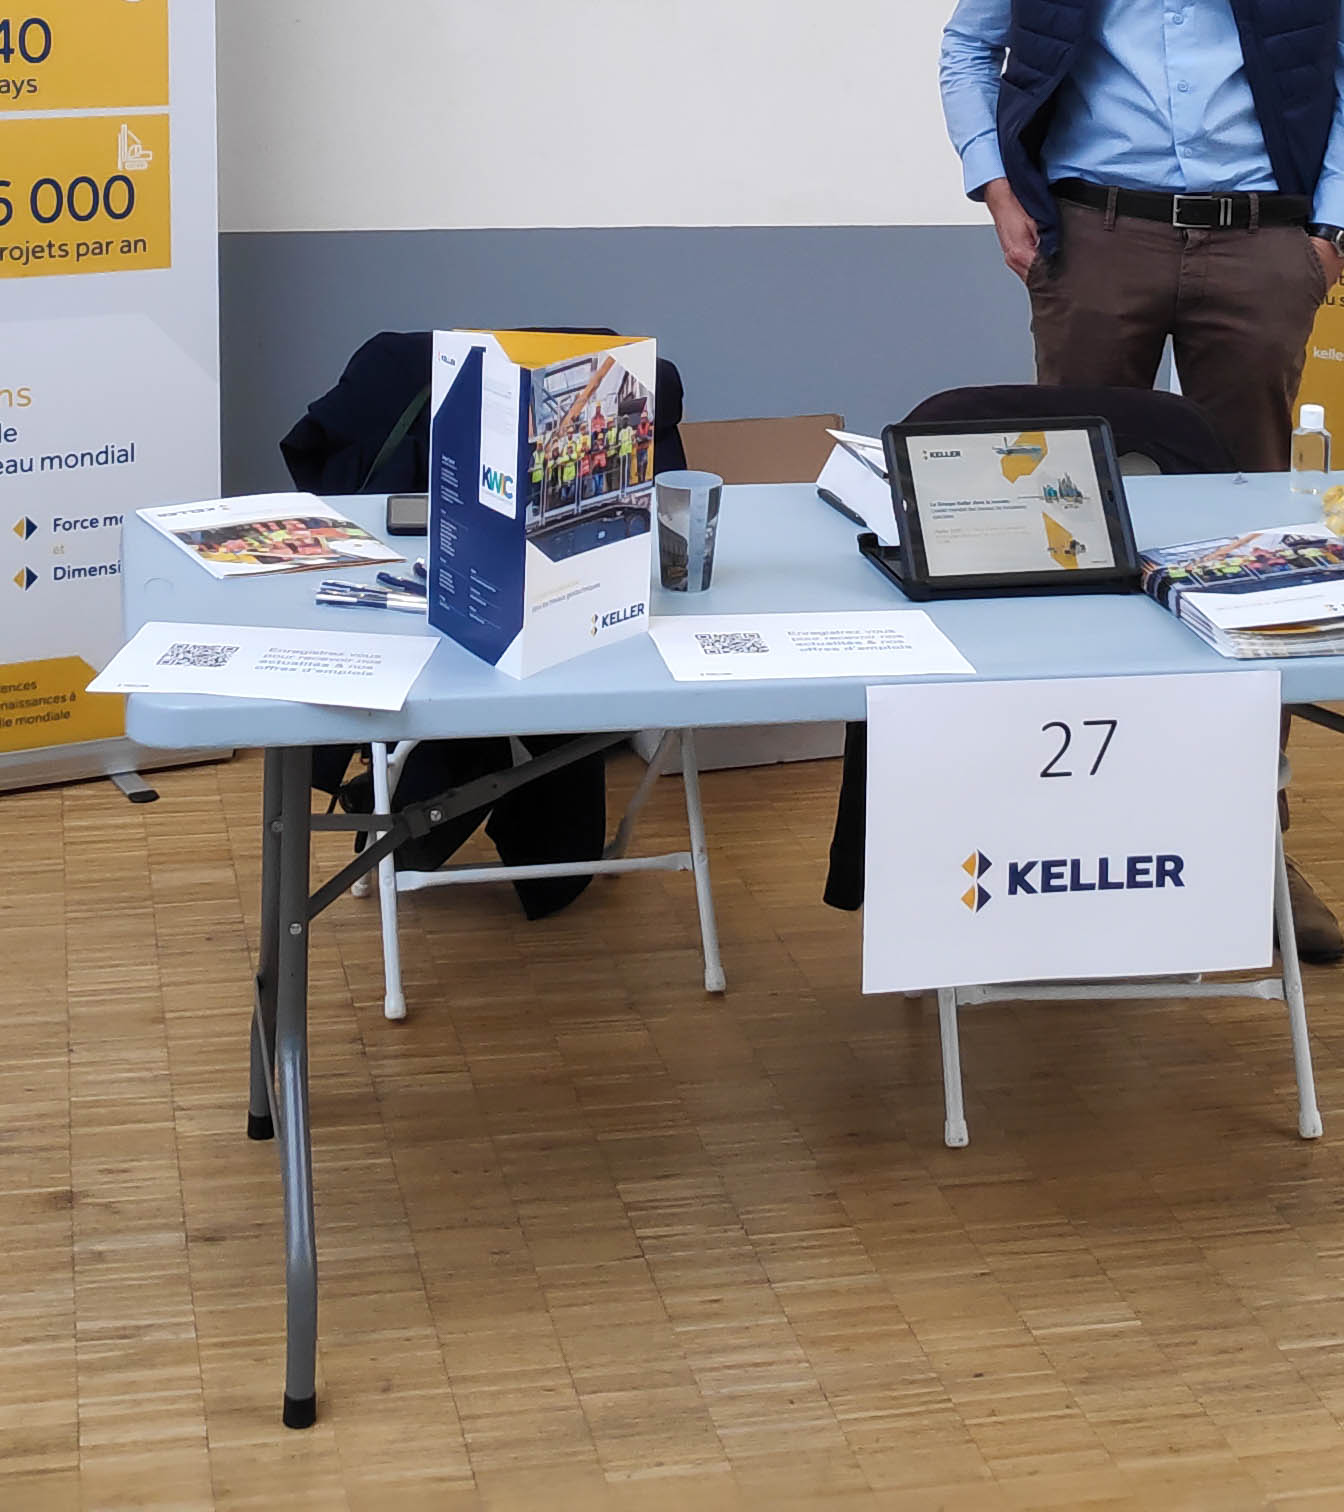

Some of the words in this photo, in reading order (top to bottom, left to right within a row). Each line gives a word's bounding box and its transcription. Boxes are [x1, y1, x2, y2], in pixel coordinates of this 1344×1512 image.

[29, 174, 135, 224] 000
[75, 239, 114, 260] par
[119, 236, 148, 255] an
[40, 442, 135, 472] mondial
[482, 464, 514, 500] KWIC
[53, 517, 99, 532] Force
[601, 602, 645, 628] KELLER
[1040, 719, 1119, 778] 27
[1008, 854, 1186, 896] KELLER
